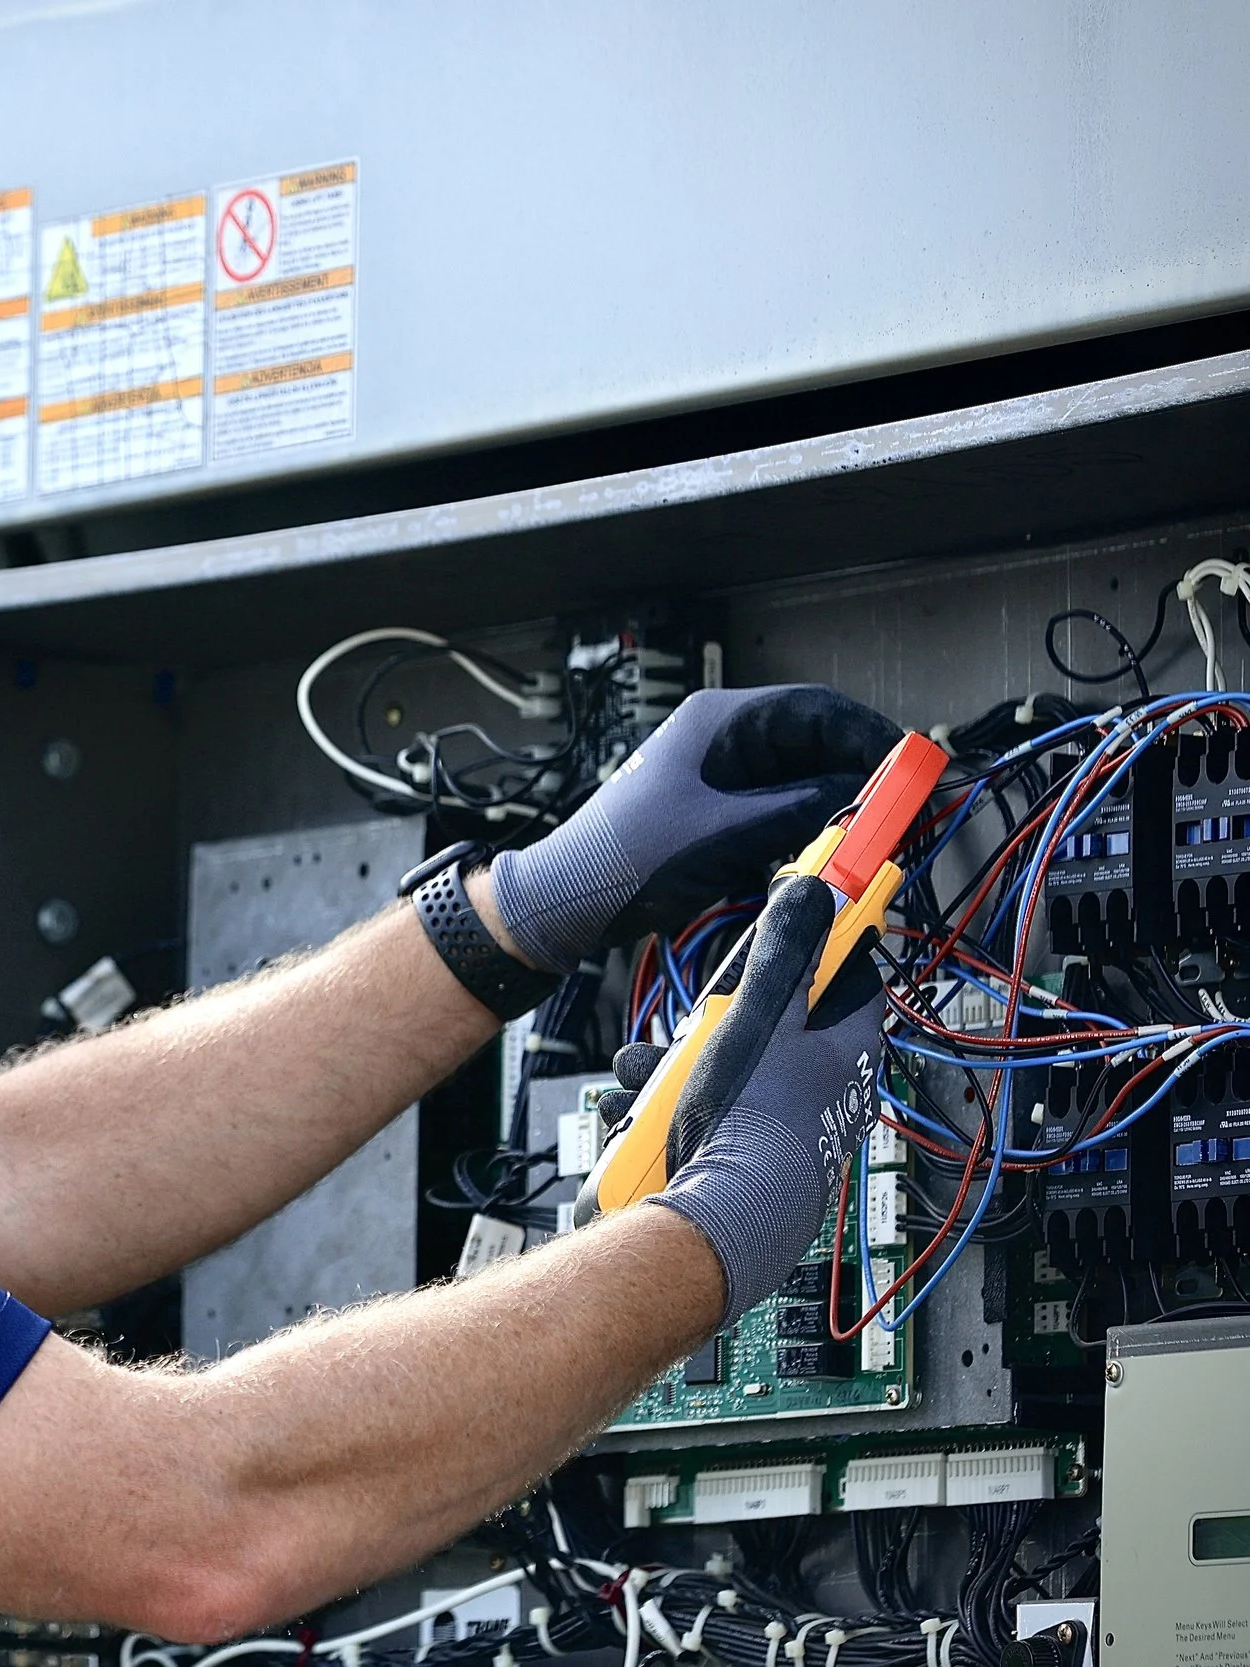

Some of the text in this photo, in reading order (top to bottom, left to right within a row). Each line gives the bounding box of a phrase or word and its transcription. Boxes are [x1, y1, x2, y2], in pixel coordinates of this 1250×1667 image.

[299, 168, 346, 188] WARNING
[1175, 1619, 1248, 1632] Menu Keys Will Select
[1175, 1631, 1236, 1642] The Desired Menu
[1200, 1652, 1214, 1661] And
